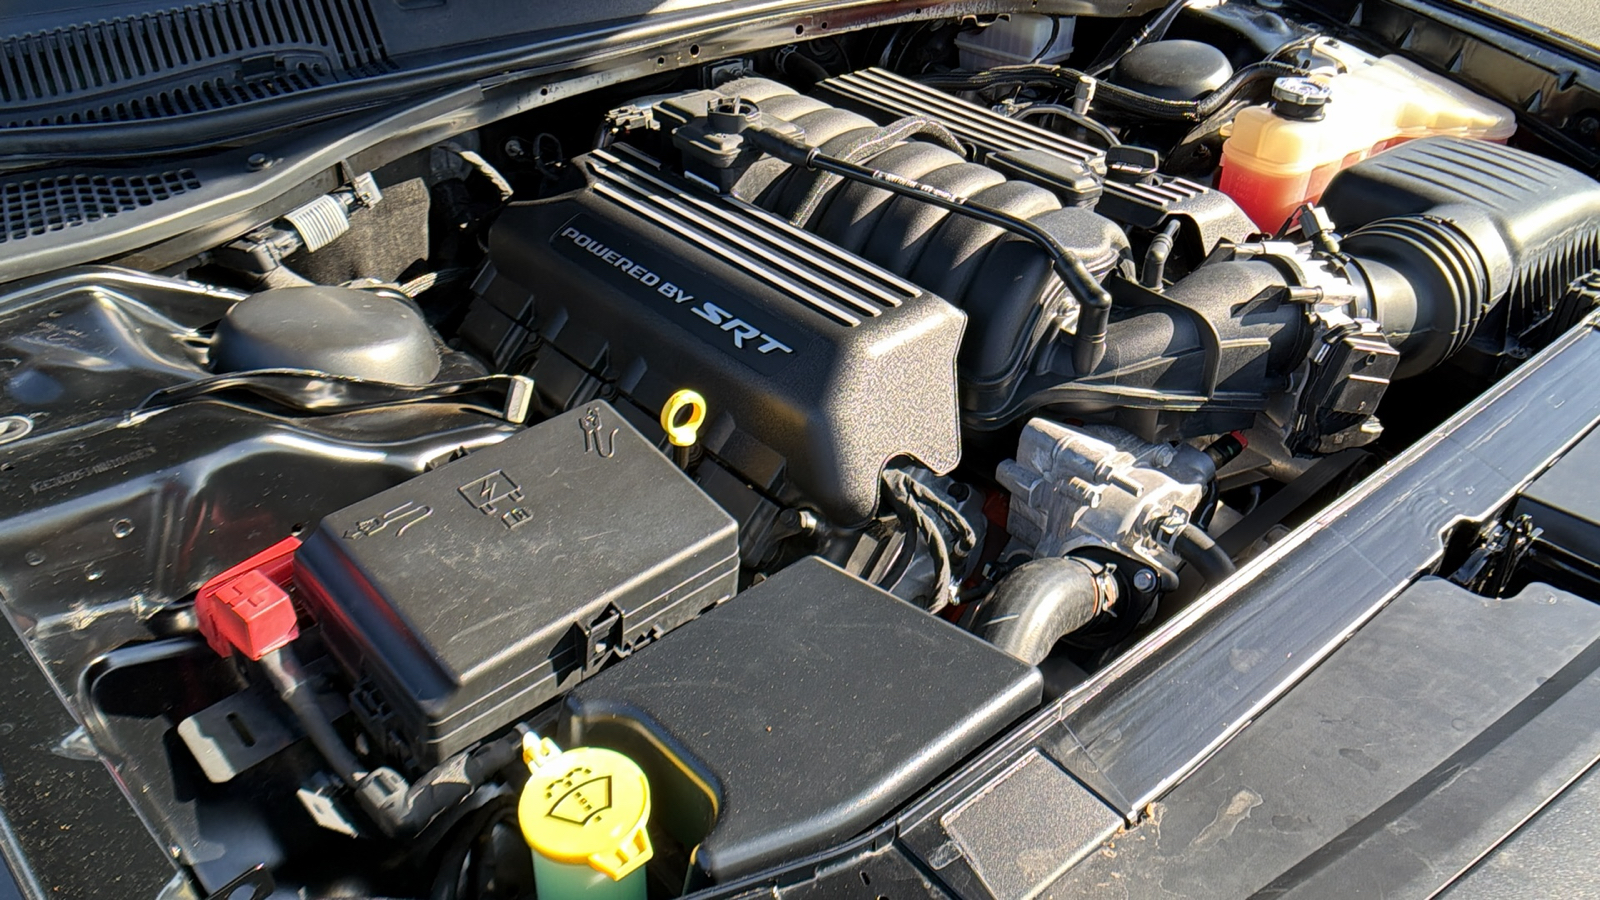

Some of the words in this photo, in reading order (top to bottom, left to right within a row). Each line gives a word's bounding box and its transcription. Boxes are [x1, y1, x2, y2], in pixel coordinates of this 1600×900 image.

[561, 227, 661, 287] POWERED
[657, 282, 694, 304] BY
[691, 301, 793, 354] SRT
